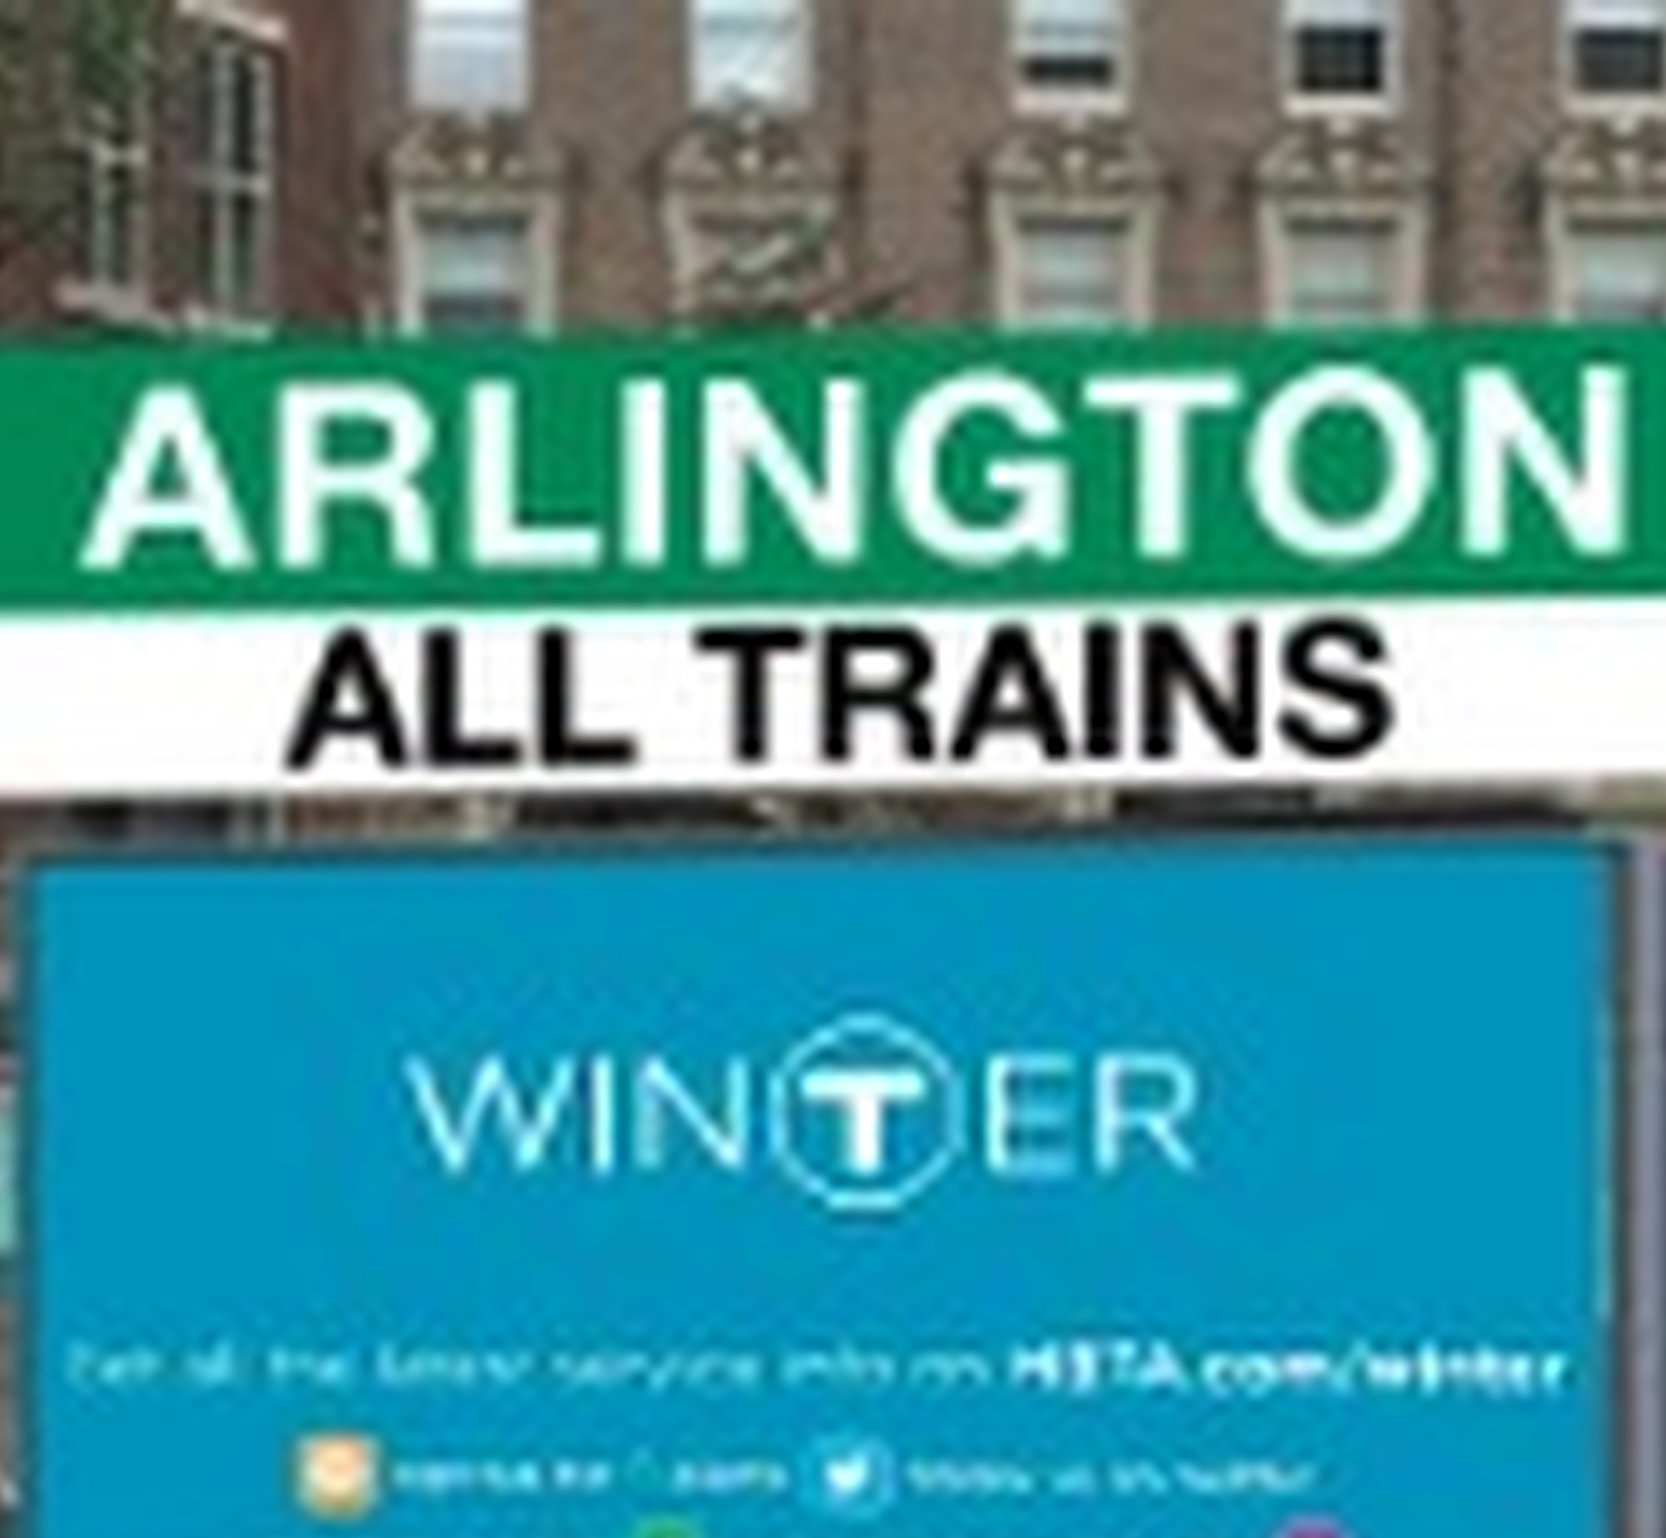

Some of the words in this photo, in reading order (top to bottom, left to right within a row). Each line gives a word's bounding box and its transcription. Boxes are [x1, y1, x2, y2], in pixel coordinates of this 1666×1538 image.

[78, 364, 1628, 571] ARLINGTON
[284, 626, 637, 770] ALL
[692, 615, 1394, 766] TRAINS
[403, 1050, 1198, 1176] WINTER
